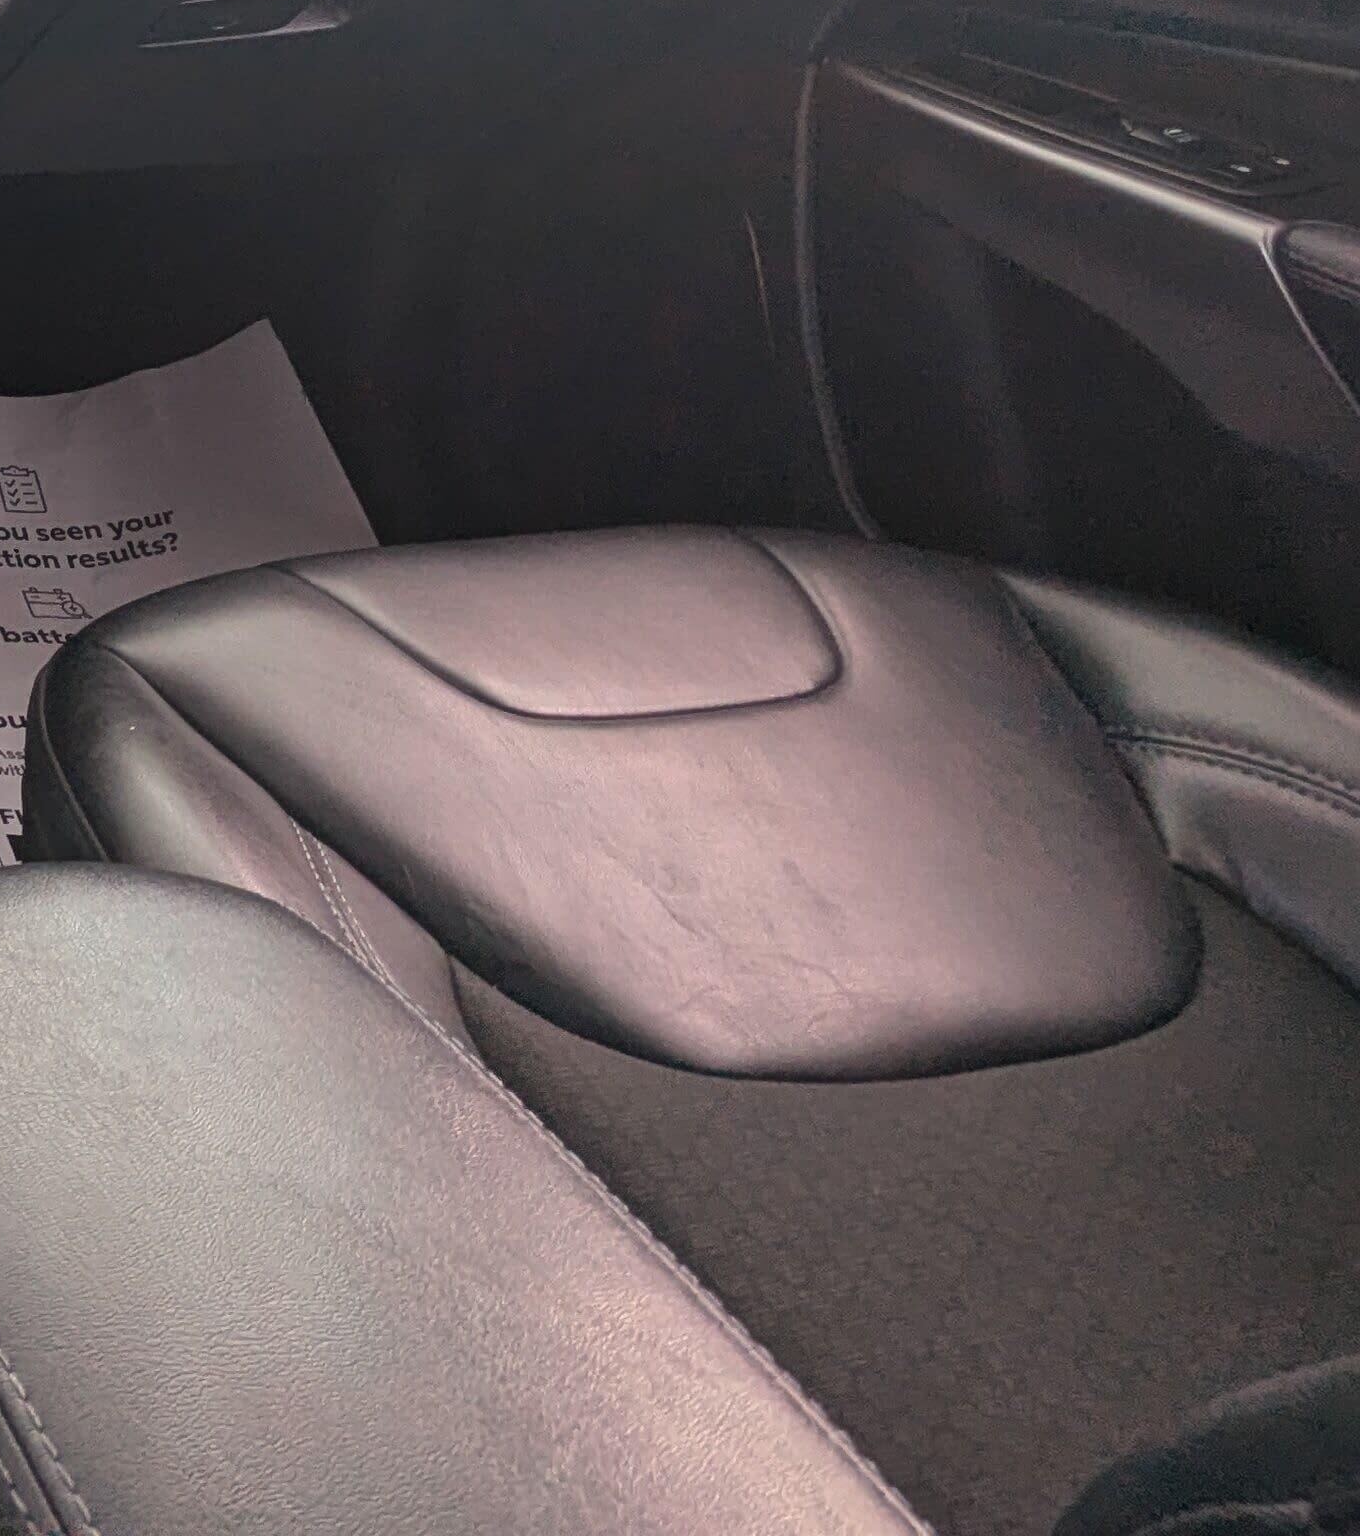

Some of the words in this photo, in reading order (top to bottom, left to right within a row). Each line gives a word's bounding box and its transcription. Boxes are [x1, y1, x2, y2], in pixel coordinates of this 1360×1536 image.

[36, 524, 102, 542] seen
[107, 510, 174, 533] your
[68, 532, 178, 569] results?
